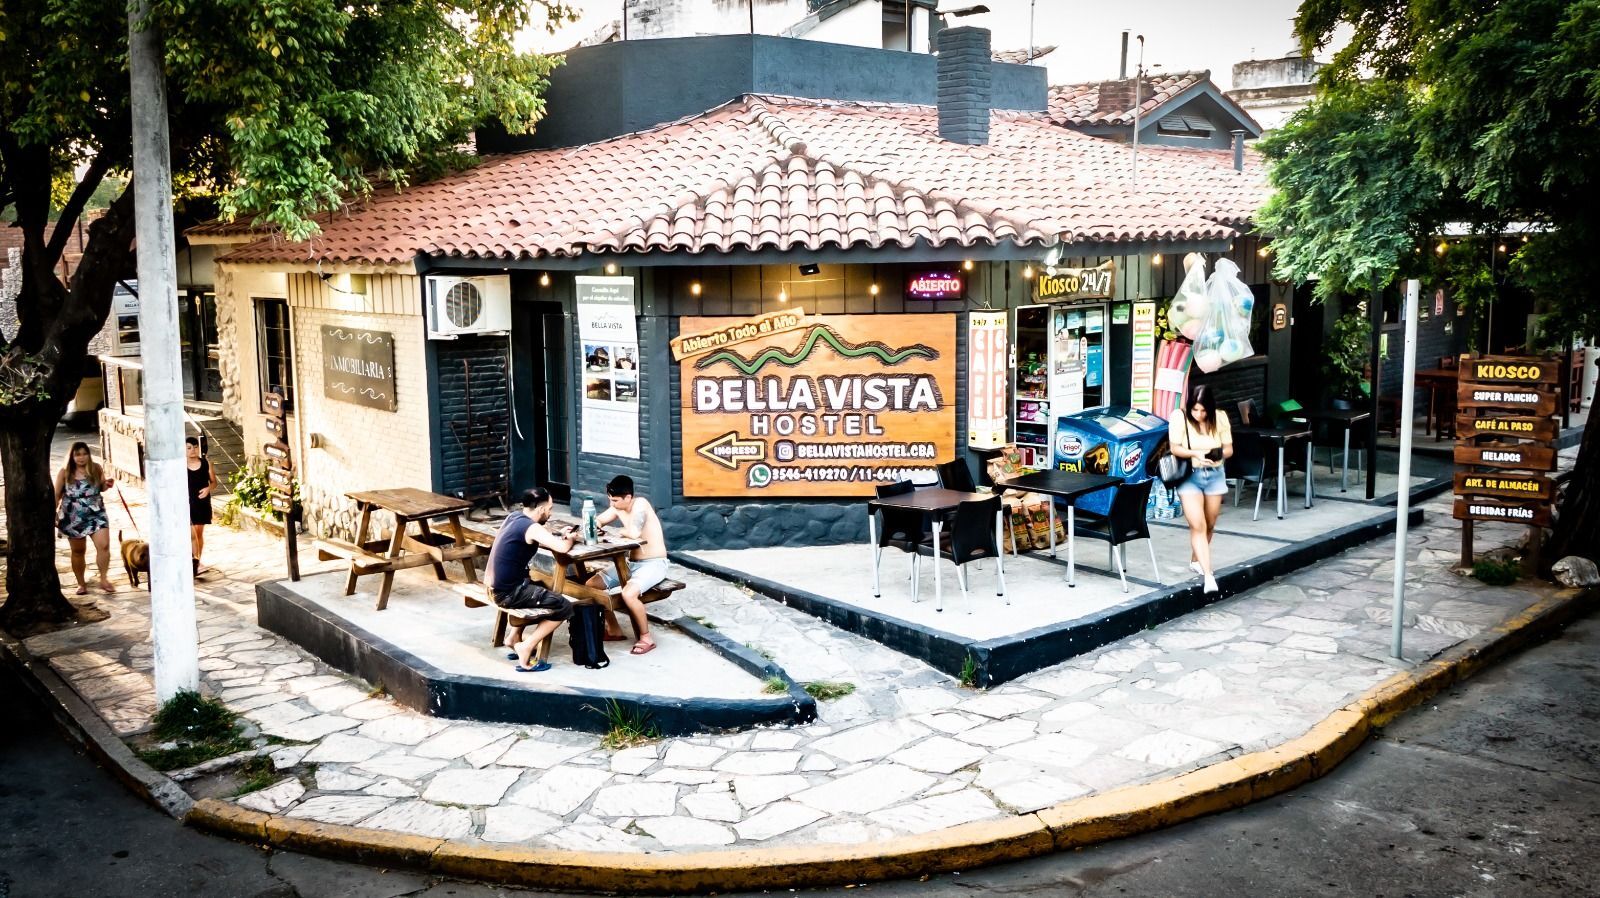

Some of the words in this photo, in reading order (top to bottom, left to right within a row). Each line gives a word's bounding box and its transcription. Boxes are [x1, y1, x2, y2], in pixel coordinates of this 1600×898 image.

[910, 279, 960, 291] ABIERTO
[1039, 274, 1078, 296] Kiosco
[1081, 271, 1112, 292] 24/7
[591, 321, 607, 329] BELLA
[682, 334, 728, 353] Abierto
[729, 326, 758, 341] Todo
[760, 320, 772, 333] el
[773, 314, 797, 330] Año
[330, 354, 385, 380] INMOBILIARIA
[1477, 365, 1540, 380] KIOSCO
[696, 378, 817, 411] BELLA
[824, 377, 938, 410] VISTA
[1474, 391, 1502, 402] SUPER
[1503, 392, 1539, 403] PANCHO
[752, 415, 883, 435] HOSTEL
[1475, 418, 1497, 430] CAFÉ
[1498, 421, 1509, 430] AL
[1511, 422, 1534, 432] PASO
[713, 446, 758, 456] INGRESO
[797, 444, 935, 459] BELLAVISTAHOSTEL.CBA
[1063, 444, 1080, 452] Frigor
[1124, 452, 1142, 470] Frigor
[1482, 451, 1521, 463] HELADOS
[772, 467, 847, 481] 3546-419270
[1465, 478, 1484, 488] ART.
[1486, 479, 1497, 489] DE
[1498, 480, 1539, 492] ALMACÉN
[1469, 505, 1506, 517] BEBIDAS
[1507, 505, 1534, 519] FRÍAS
